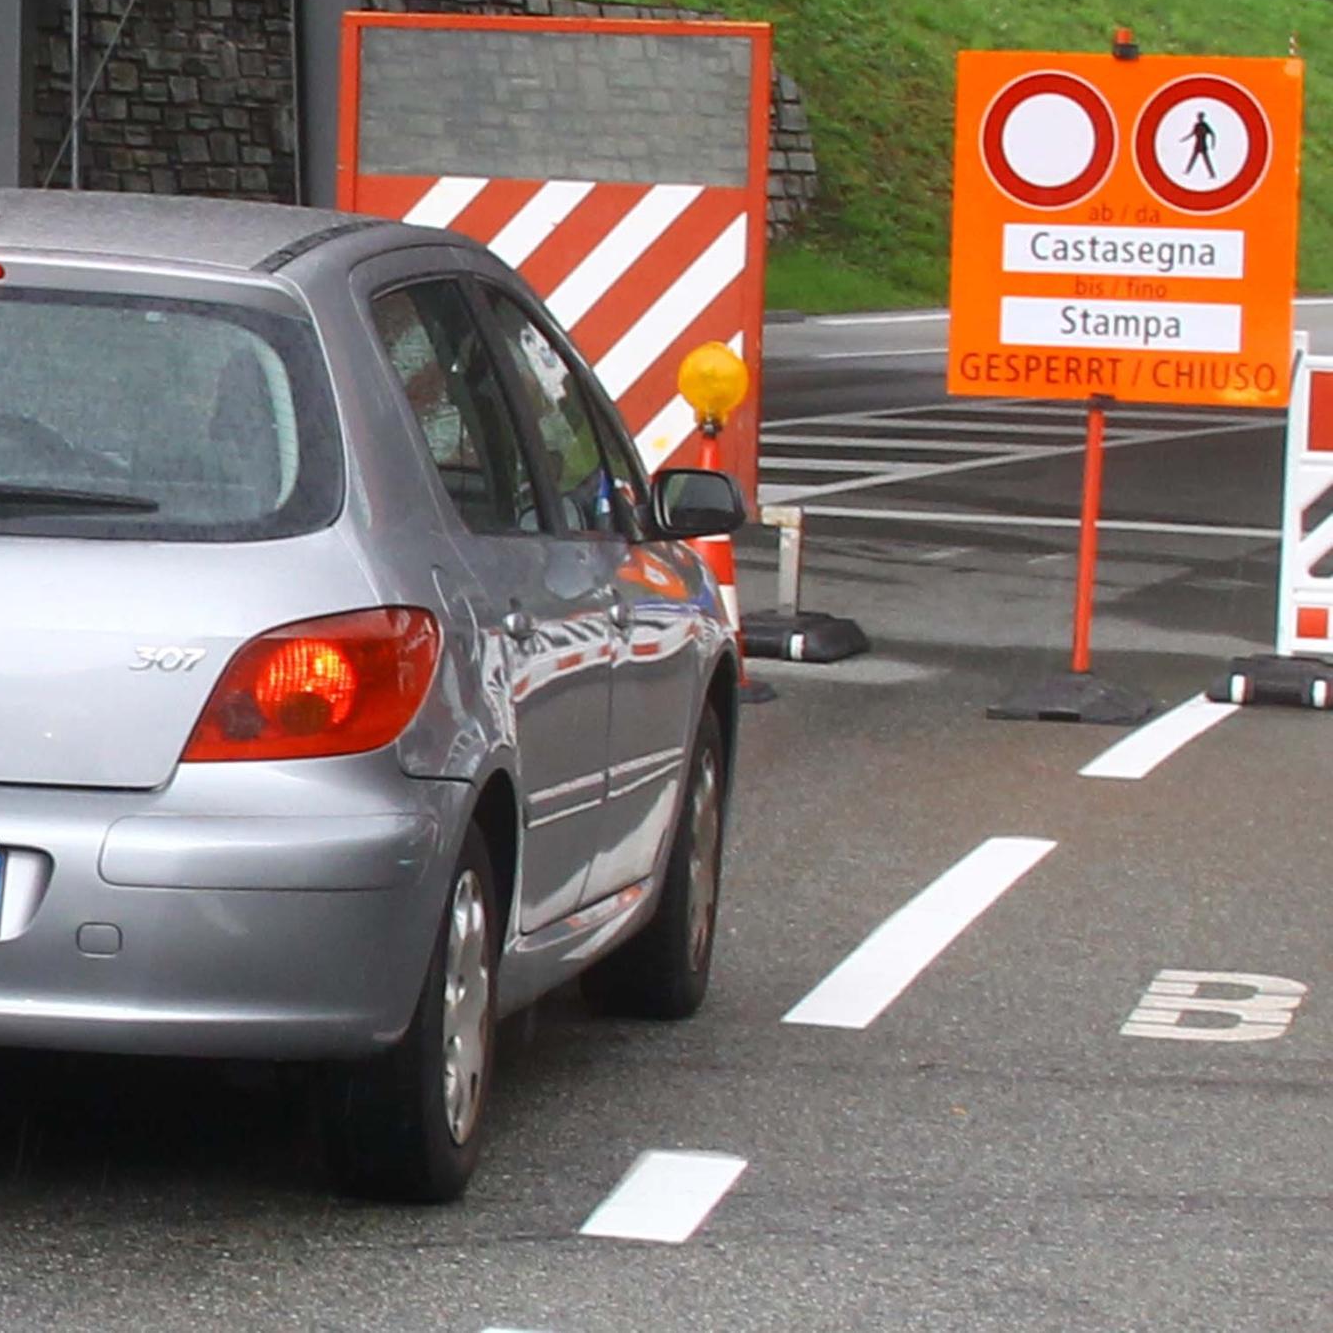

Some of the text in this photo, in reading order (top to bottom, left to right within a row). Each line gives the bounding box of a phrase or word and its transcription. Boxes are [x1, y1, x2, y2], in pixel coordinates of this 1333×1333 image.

[1088, 204, 1161, 224] ab / da
[1030, 231, 1216, 273] Castasegna
[1075, 277, 1168, 299] bis / fino
[1060, 305, 1181, 344] Stampa
[959, 352, 1276, 393] GESPERRT / CHIUSO
[127, 645, 207, 673] 307
[1119, 969, 1309, 1042] B
